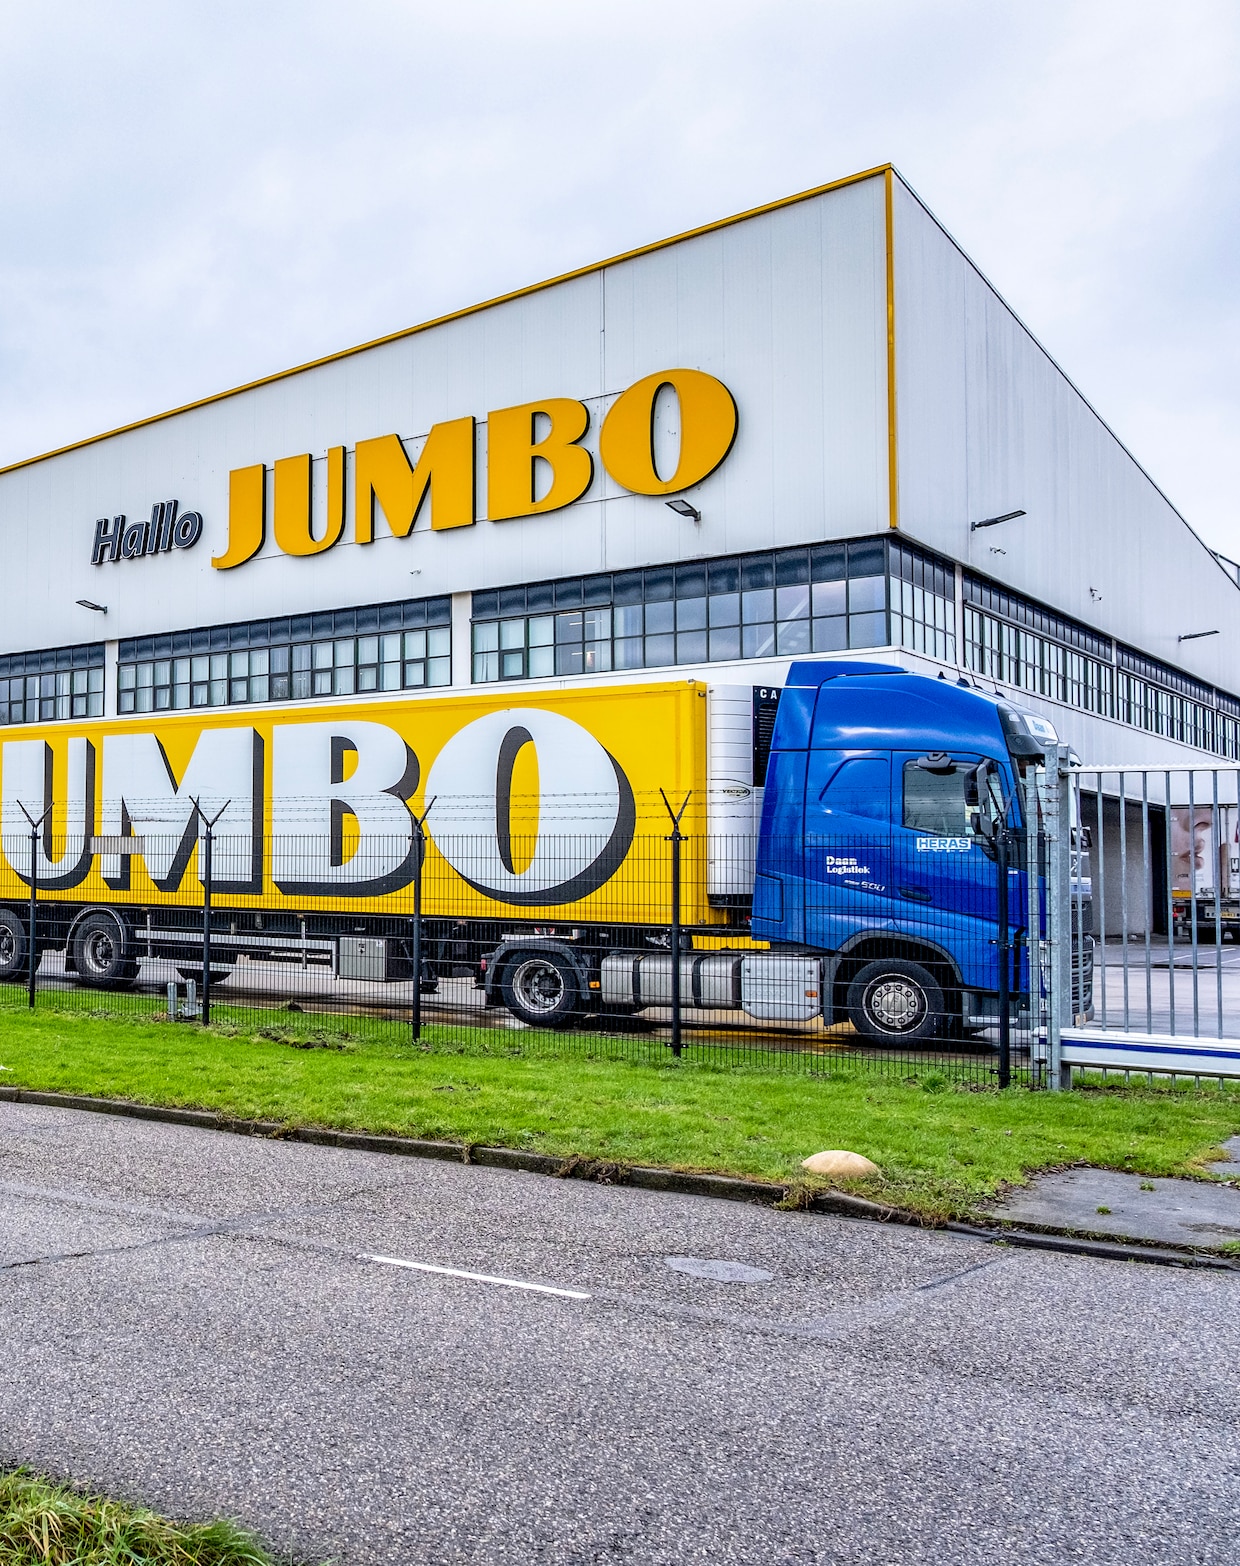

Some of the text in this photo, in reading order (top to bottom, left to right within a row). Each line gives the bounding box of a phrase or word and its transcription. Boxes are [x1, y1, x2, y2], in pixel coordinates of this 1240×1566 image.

[91, 368, 739, 571] Hallo JUMBO
[919, 838, 969, 848] HERAS
[826, 855, 858, 866] Daan
